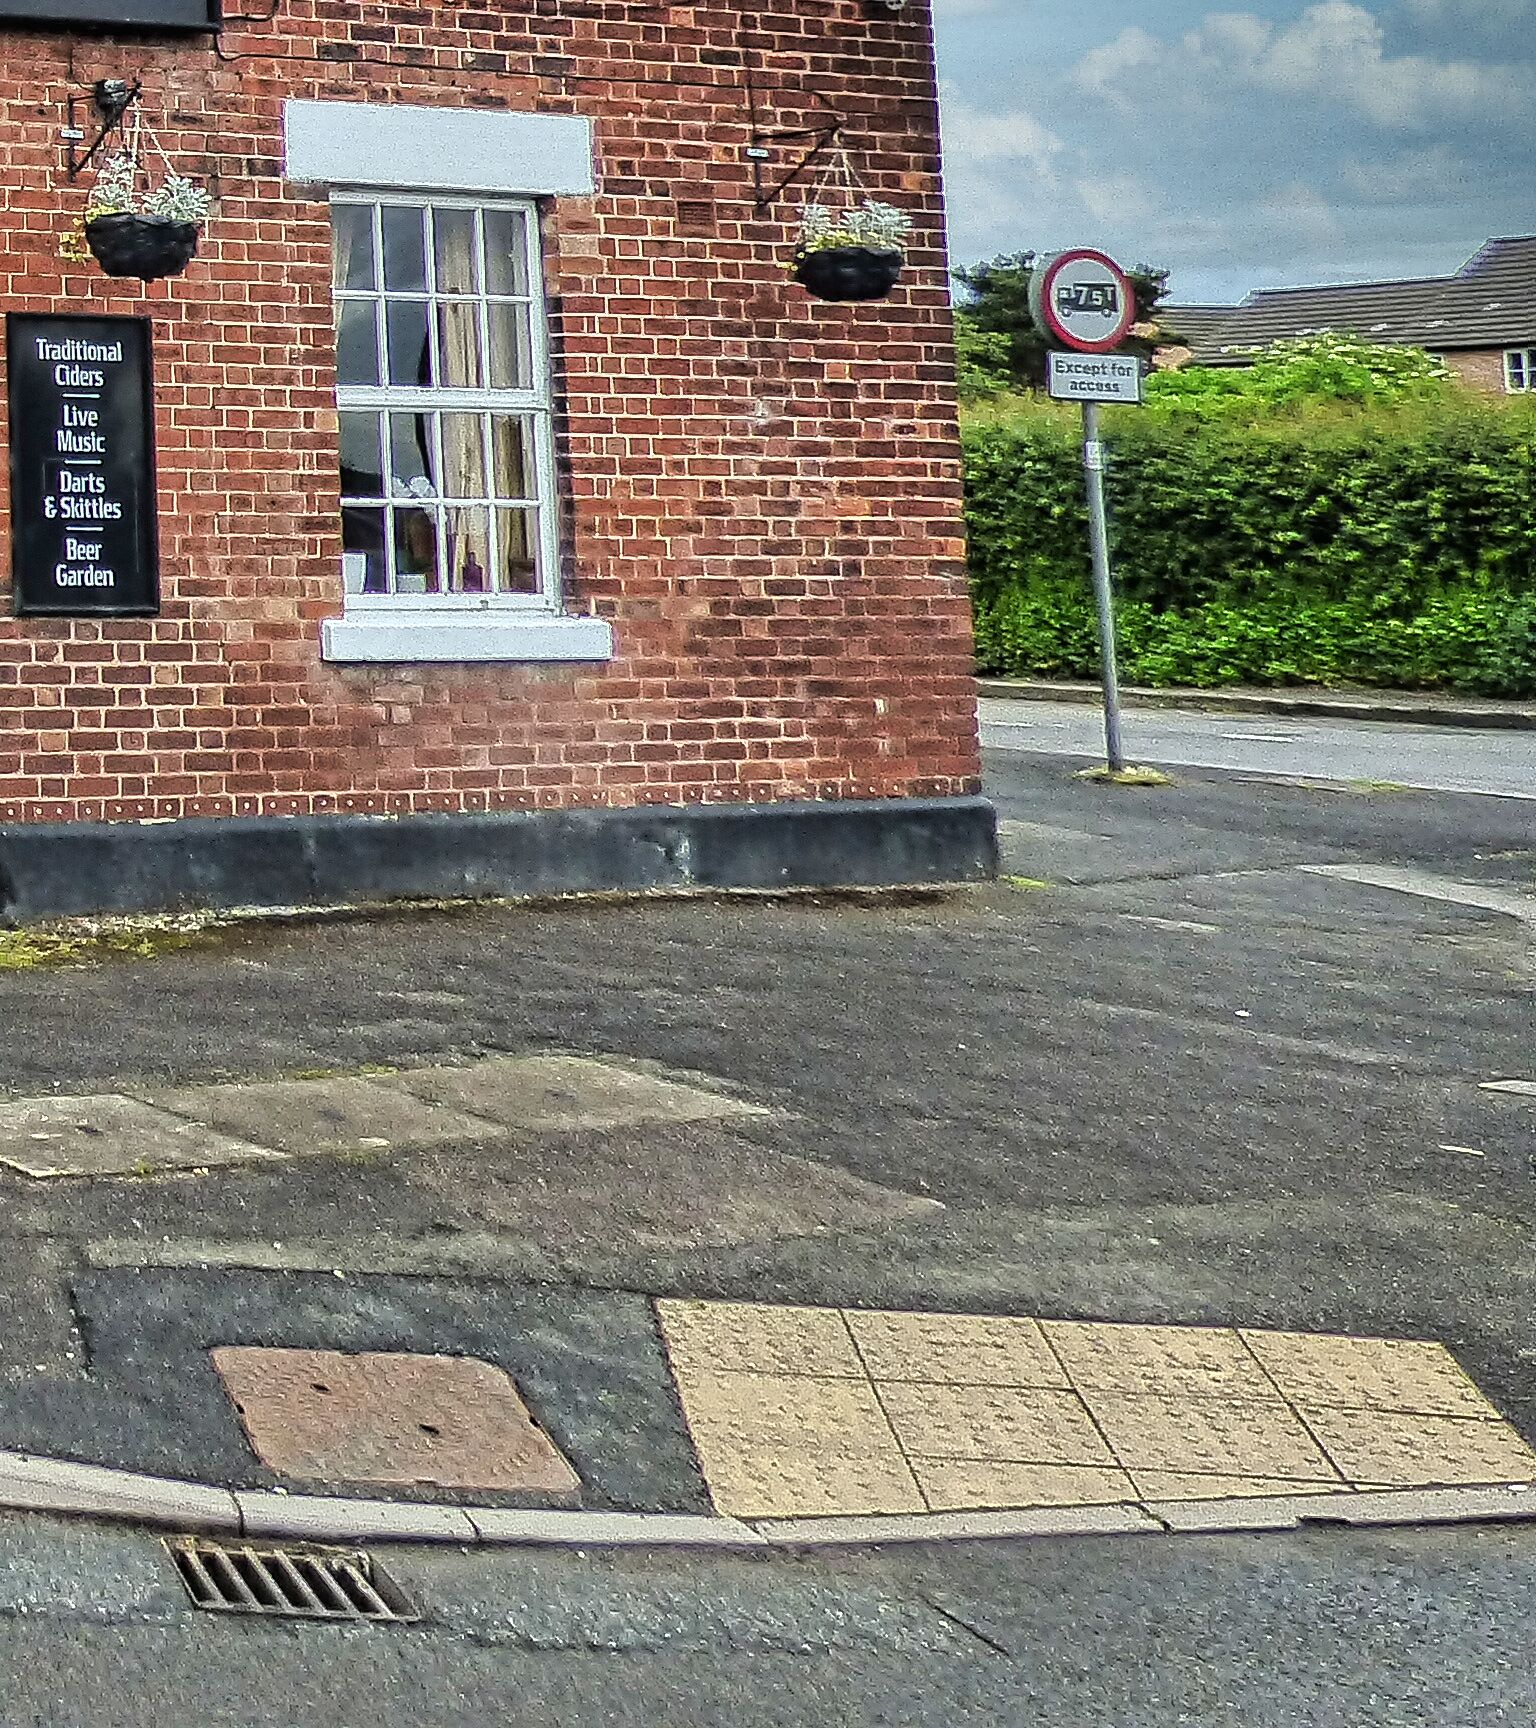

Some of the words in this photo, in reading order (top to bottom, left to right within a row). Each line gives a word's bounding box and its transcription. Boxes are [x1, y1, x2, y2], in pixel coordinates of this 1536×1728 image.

[36, 337, 123, 363] Traditional
[54, 364, 104, 388] Ciders
[1055, 359, 1107, 377] Except
[1111, 362, 1133, 377] for
[1069, 380, 1120, 392] access
[62, 404, 98, 428] Live
[57, 430, 106, 453] Music
[59, 470, 106, 494] Darts
[43, 496, 58, 519] &
[60, 496, 122, 520] Skittles
[65, 538, 103, 561] Beer
[55, 564, 115, 588] Garden
